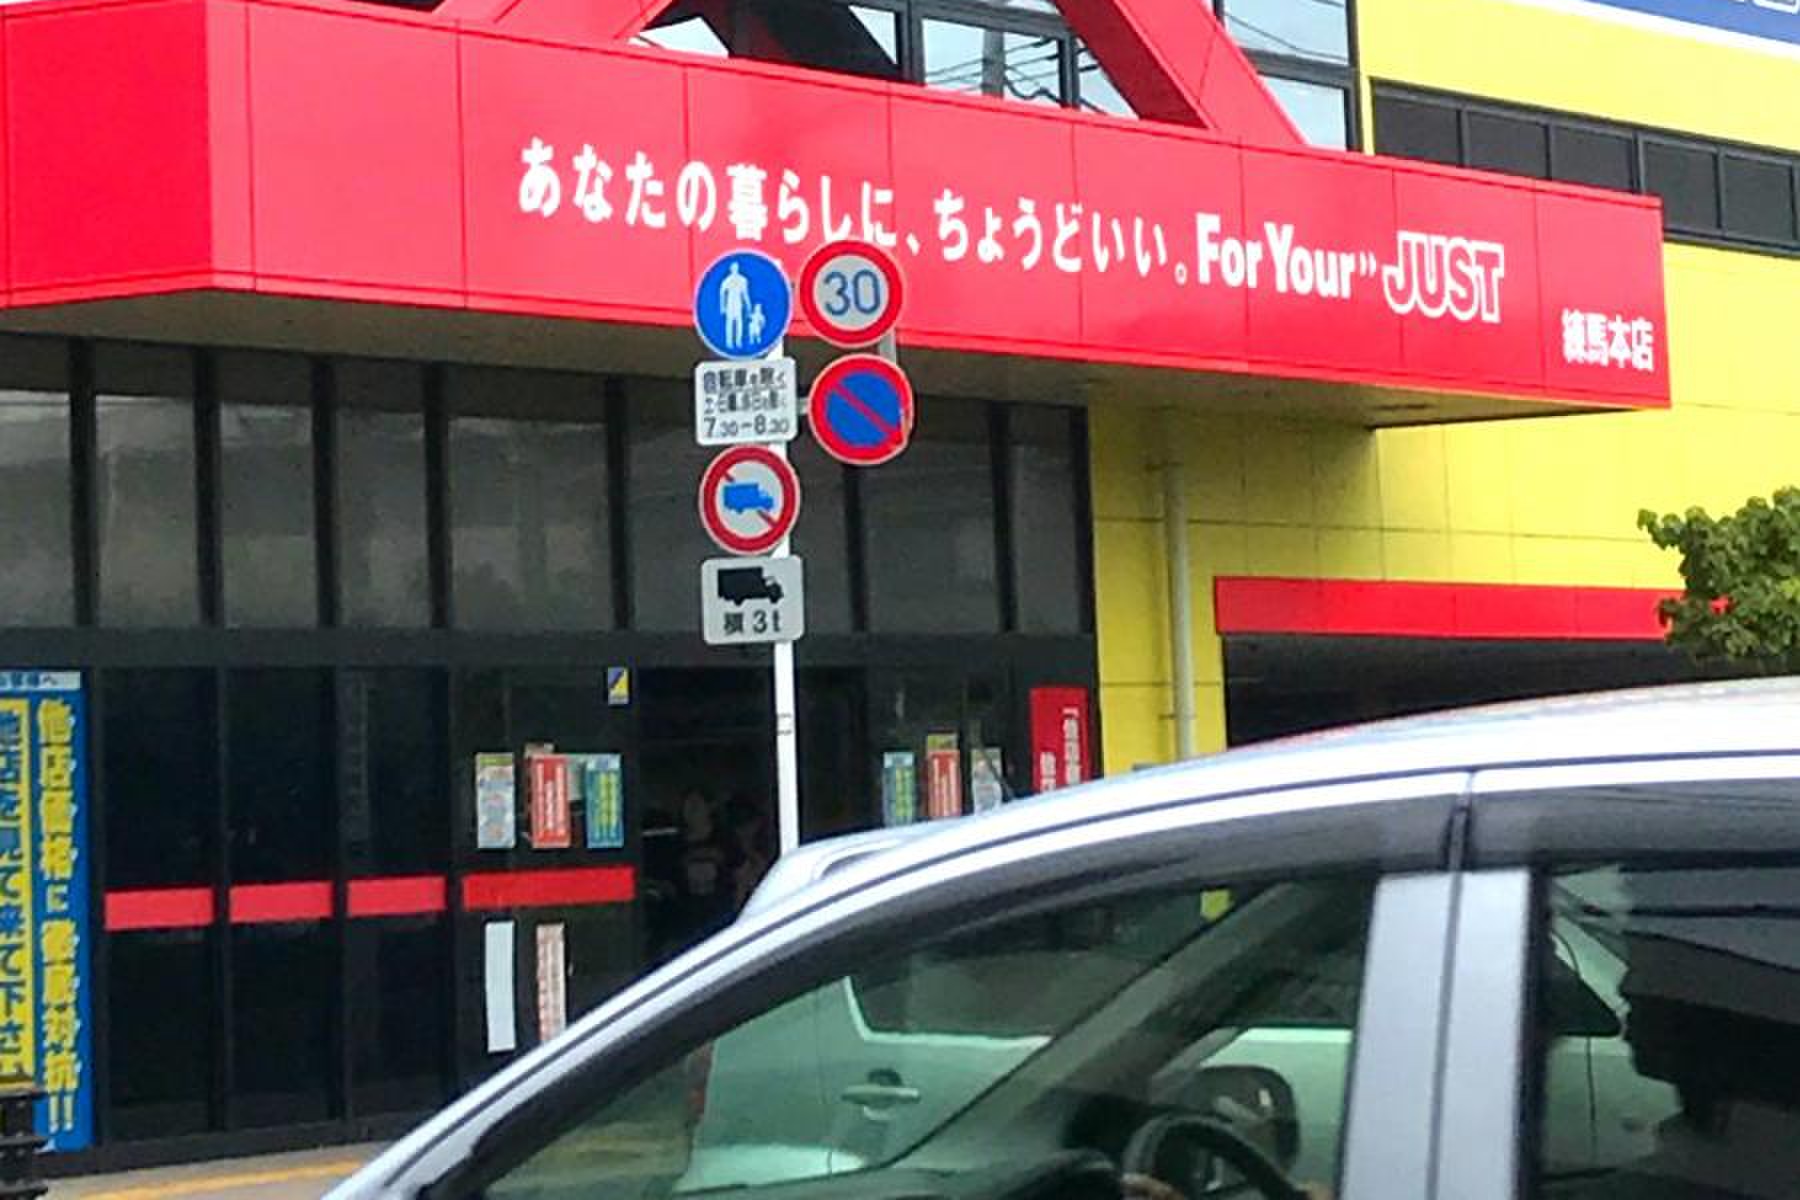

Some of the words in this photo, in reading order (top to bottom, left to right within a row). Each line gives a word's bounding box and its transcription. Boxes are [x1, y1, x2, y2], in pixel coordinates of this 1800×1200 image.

[824, 269, 881, 316] 30
[1196, 213, 1263, 288] For
[1382, 231, 1505, 323] JUST
[1562, 308, 1654, 371] 練馬本店
